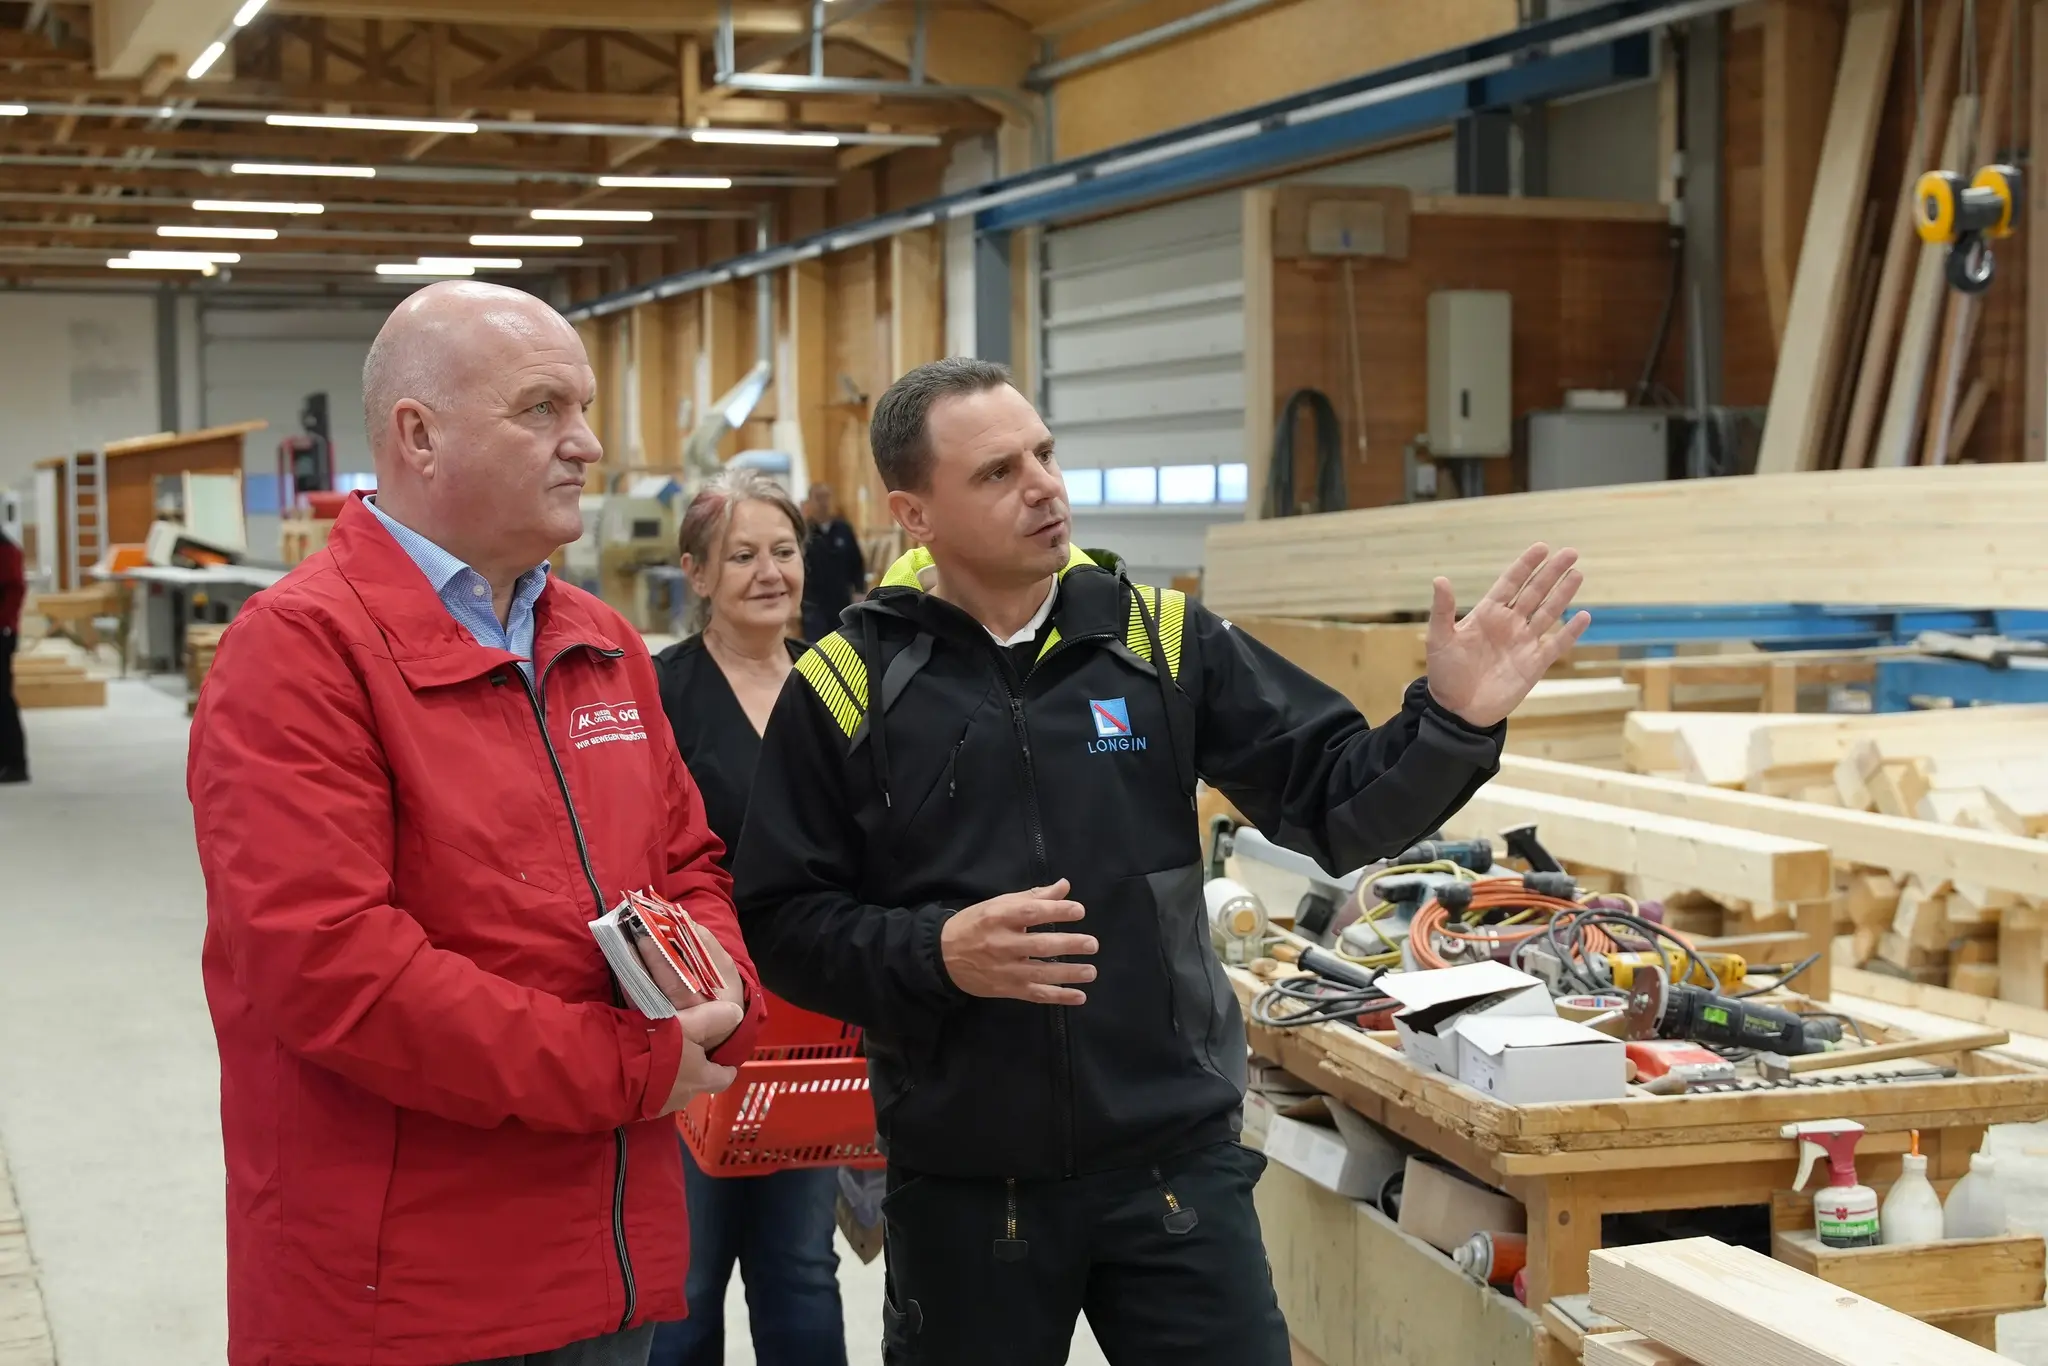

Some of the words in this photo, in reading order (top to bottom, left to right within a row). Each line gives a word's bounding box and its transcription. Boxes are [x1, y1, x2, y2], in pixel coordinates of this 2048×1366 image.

[578, 713, 596, 730] AK
[575, 739, 591, 750] WIR
[1087, 736, 1147, 754] LONGIN
